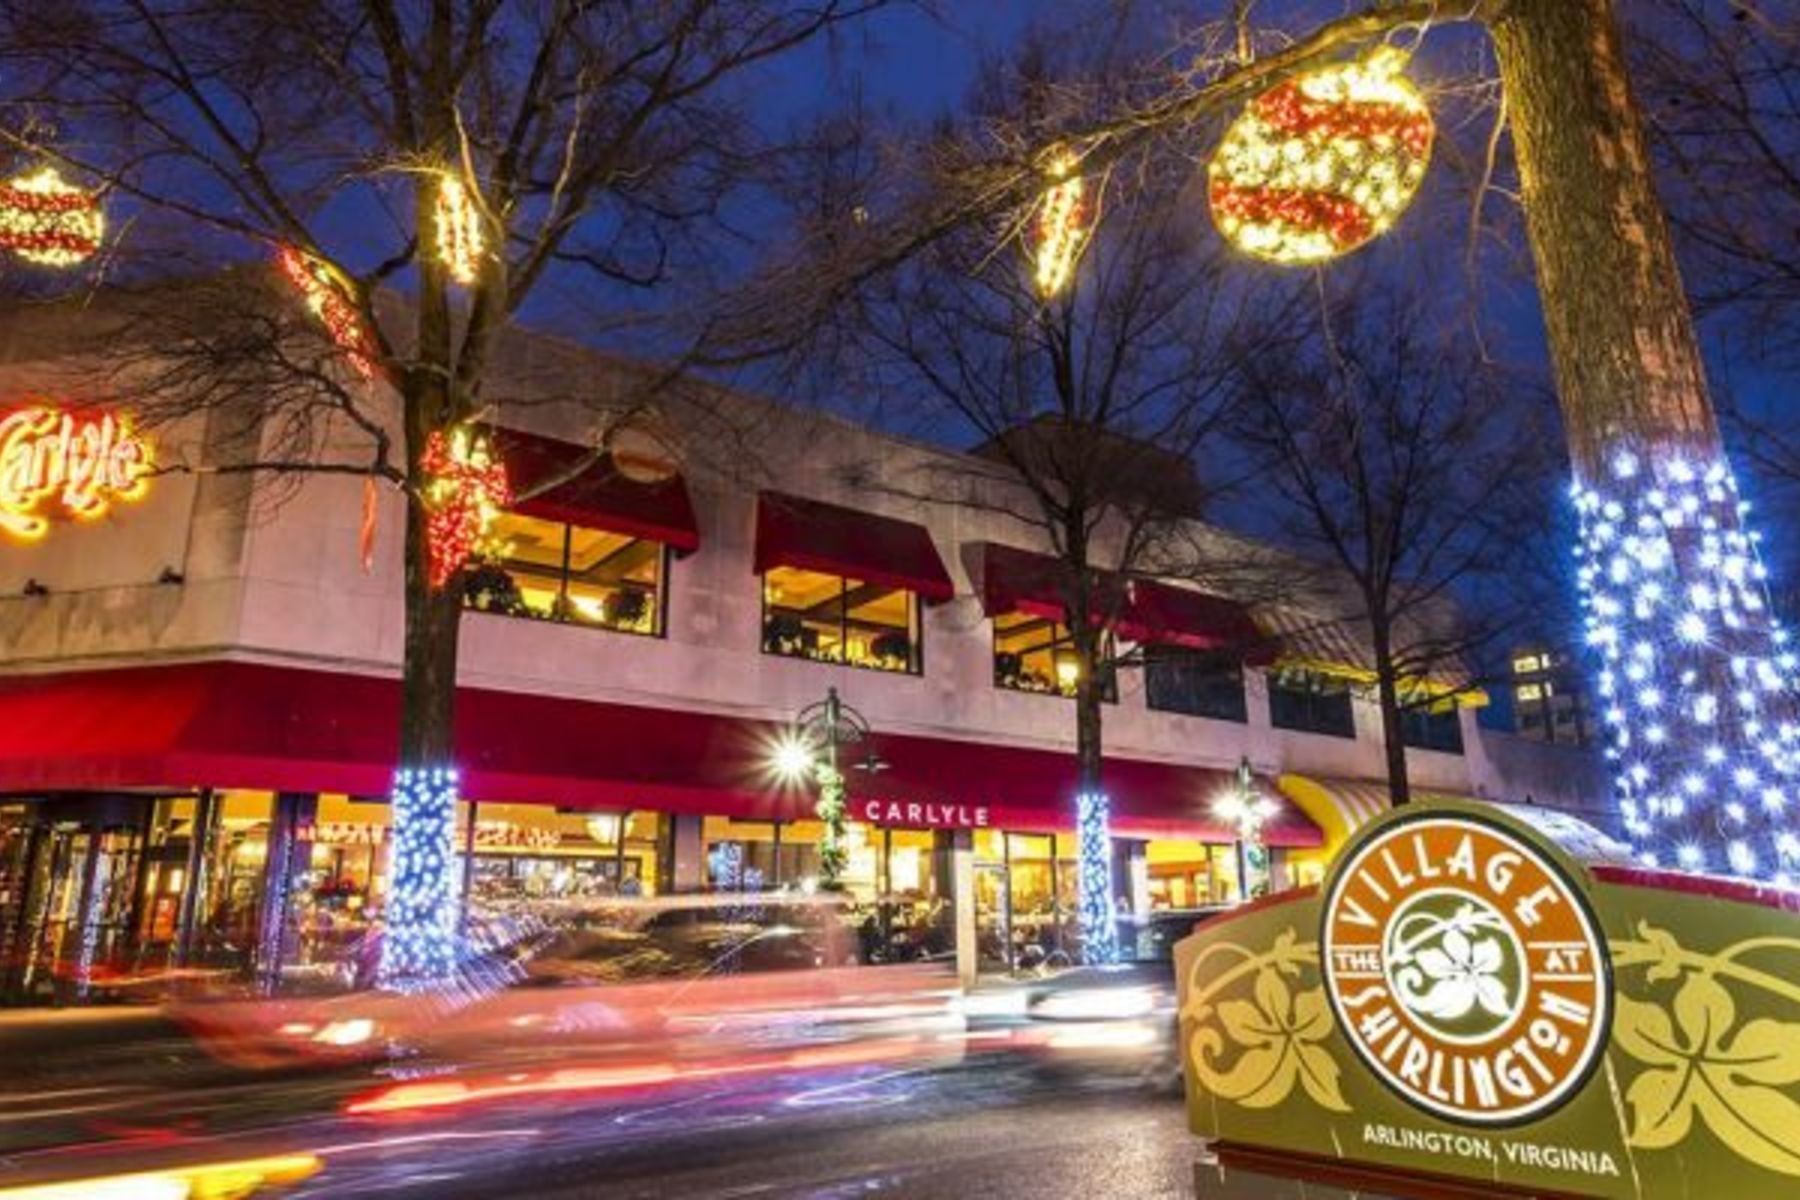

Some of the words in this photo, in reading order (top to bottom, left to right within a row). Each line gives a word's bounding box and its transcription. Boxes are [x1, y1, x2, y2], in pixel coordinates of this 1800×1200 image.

[0, 407, 154, 537] Carlyle
[865, 800, 989, 827] CARLYLE
[1338, 833, 1560, 928] VILLAGE
[1337, 952, 1382, 972] THE
[1544, 950, 1584, 973] AT
[1341, 985, 1592, 1107] SHIRLINGTON
[1363, 1123, 1499, 1162] ARLINGTON,
[1502, 1140, 1620, 1177] VIRGINIA
